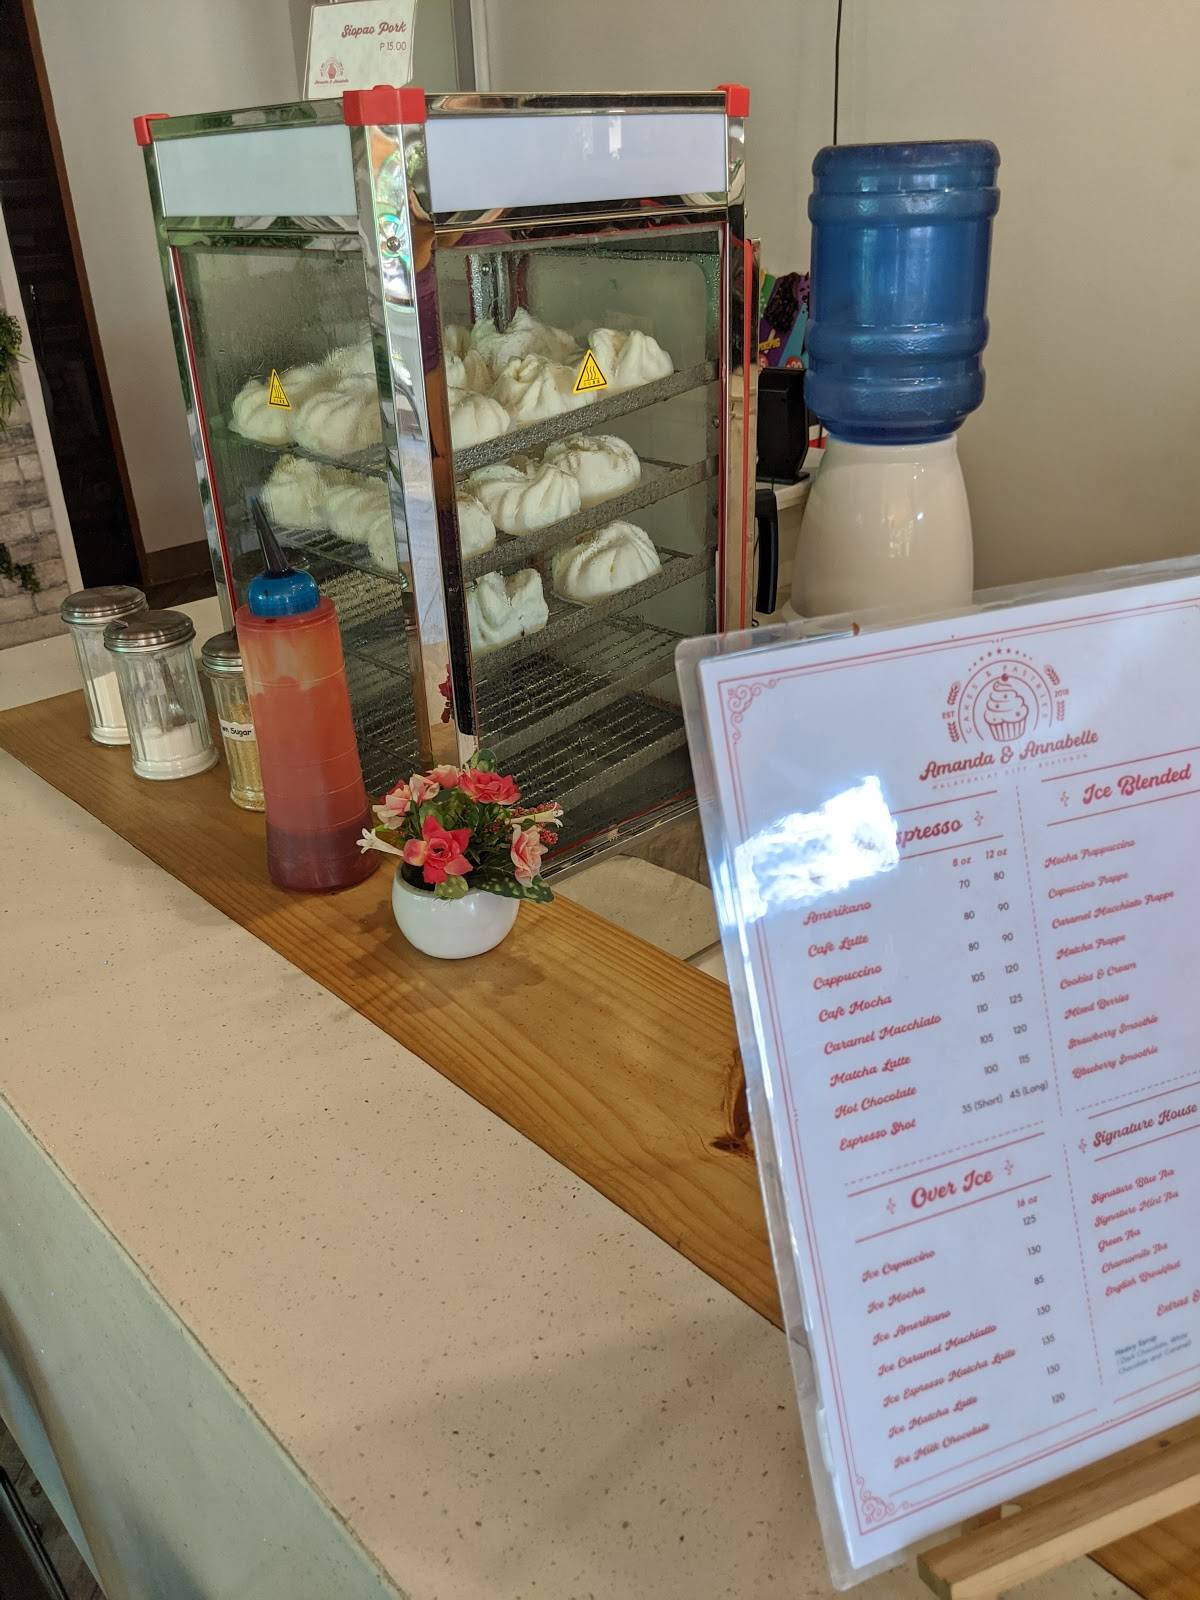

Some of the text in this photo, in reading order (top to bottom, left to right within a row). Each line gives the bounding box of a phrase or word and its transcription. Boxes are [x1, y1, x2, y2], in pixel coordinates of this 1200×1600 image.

[341, 21, 407, 38] Siopao Pork
[387, 41, 407, 51] 15.00
[942, 711, 955, 720] EST
[230, 727, 252, 737] Sugar
[919, 729, 1099, 781] Amanda & Annabelle
[1081, 762, 1193, 806] Ice Blended
[895, 818, 964, 849] spresso
[960, 856, 972, 866] oz
[985, 849, 995, 860] 12
[996, 848, 1008, 857] oz
[1043, 852, 1079, 869] Mocha
[802, 870, 1006, 927] Amerikano 70 80
[807, 901, 1010, 959] Cafe Latte 80 90
[1051, 910, 1092, 930] Caramel
[812, 931, 1014, 991] Cappuccino 80 90
[1055, 943, 1095, 961] Matcha
[1059, 961, 1137, 991] Cookies & Cream
[817, 962, 1020, 1024] Cafe Mocha 105 120
[1096, 993, 1130, 1011] Berries
[823, 992, 1024, 1056] Caramel Macchiato 110 125
[828, 1023, 1028, 1088] Matcha Latte 105 120
[833, 1053, 1031, 1120] Hot Chocolate 100 115
[838, 1128, 888, 1152] Espresso
[889, 1118, 917, 1137] Shot
[1008, 1088, 1022, 1099] 45
[1021, 1079, 1049, 1097] (Long)
[1092, 1103, 1199, 1149] Signature House
[909, 1169, 994, 1210] Over Ice
[1090, 1183, 1134, 1206] Signature
[1093, 1206, 1138, 1229] Signature
[1097, 1235, 1124, 1254] Green
[861, 1269, 881, 1284] Ice
[866, 1300, 885, 1315] Ice
[887, 1286, 927, 1308] Mocha
[871, 1331, 891, 1347] Ice
[892, 1309, 952, 1339] Amerikano
[877, 1363, 897, 1377] Ice
[896, 1343, 944, 1369] Caramel
[882, 1394, 901, 1409] Ice
[902, 1377, 946, 1401] Espresso
[947, 1359, 990, 1383] Matcha
[887, 1424, 907, 1440] Ice
[907, 1407, 950, 1432] Matcha
[893, 1455, 912, 1470] Ice
